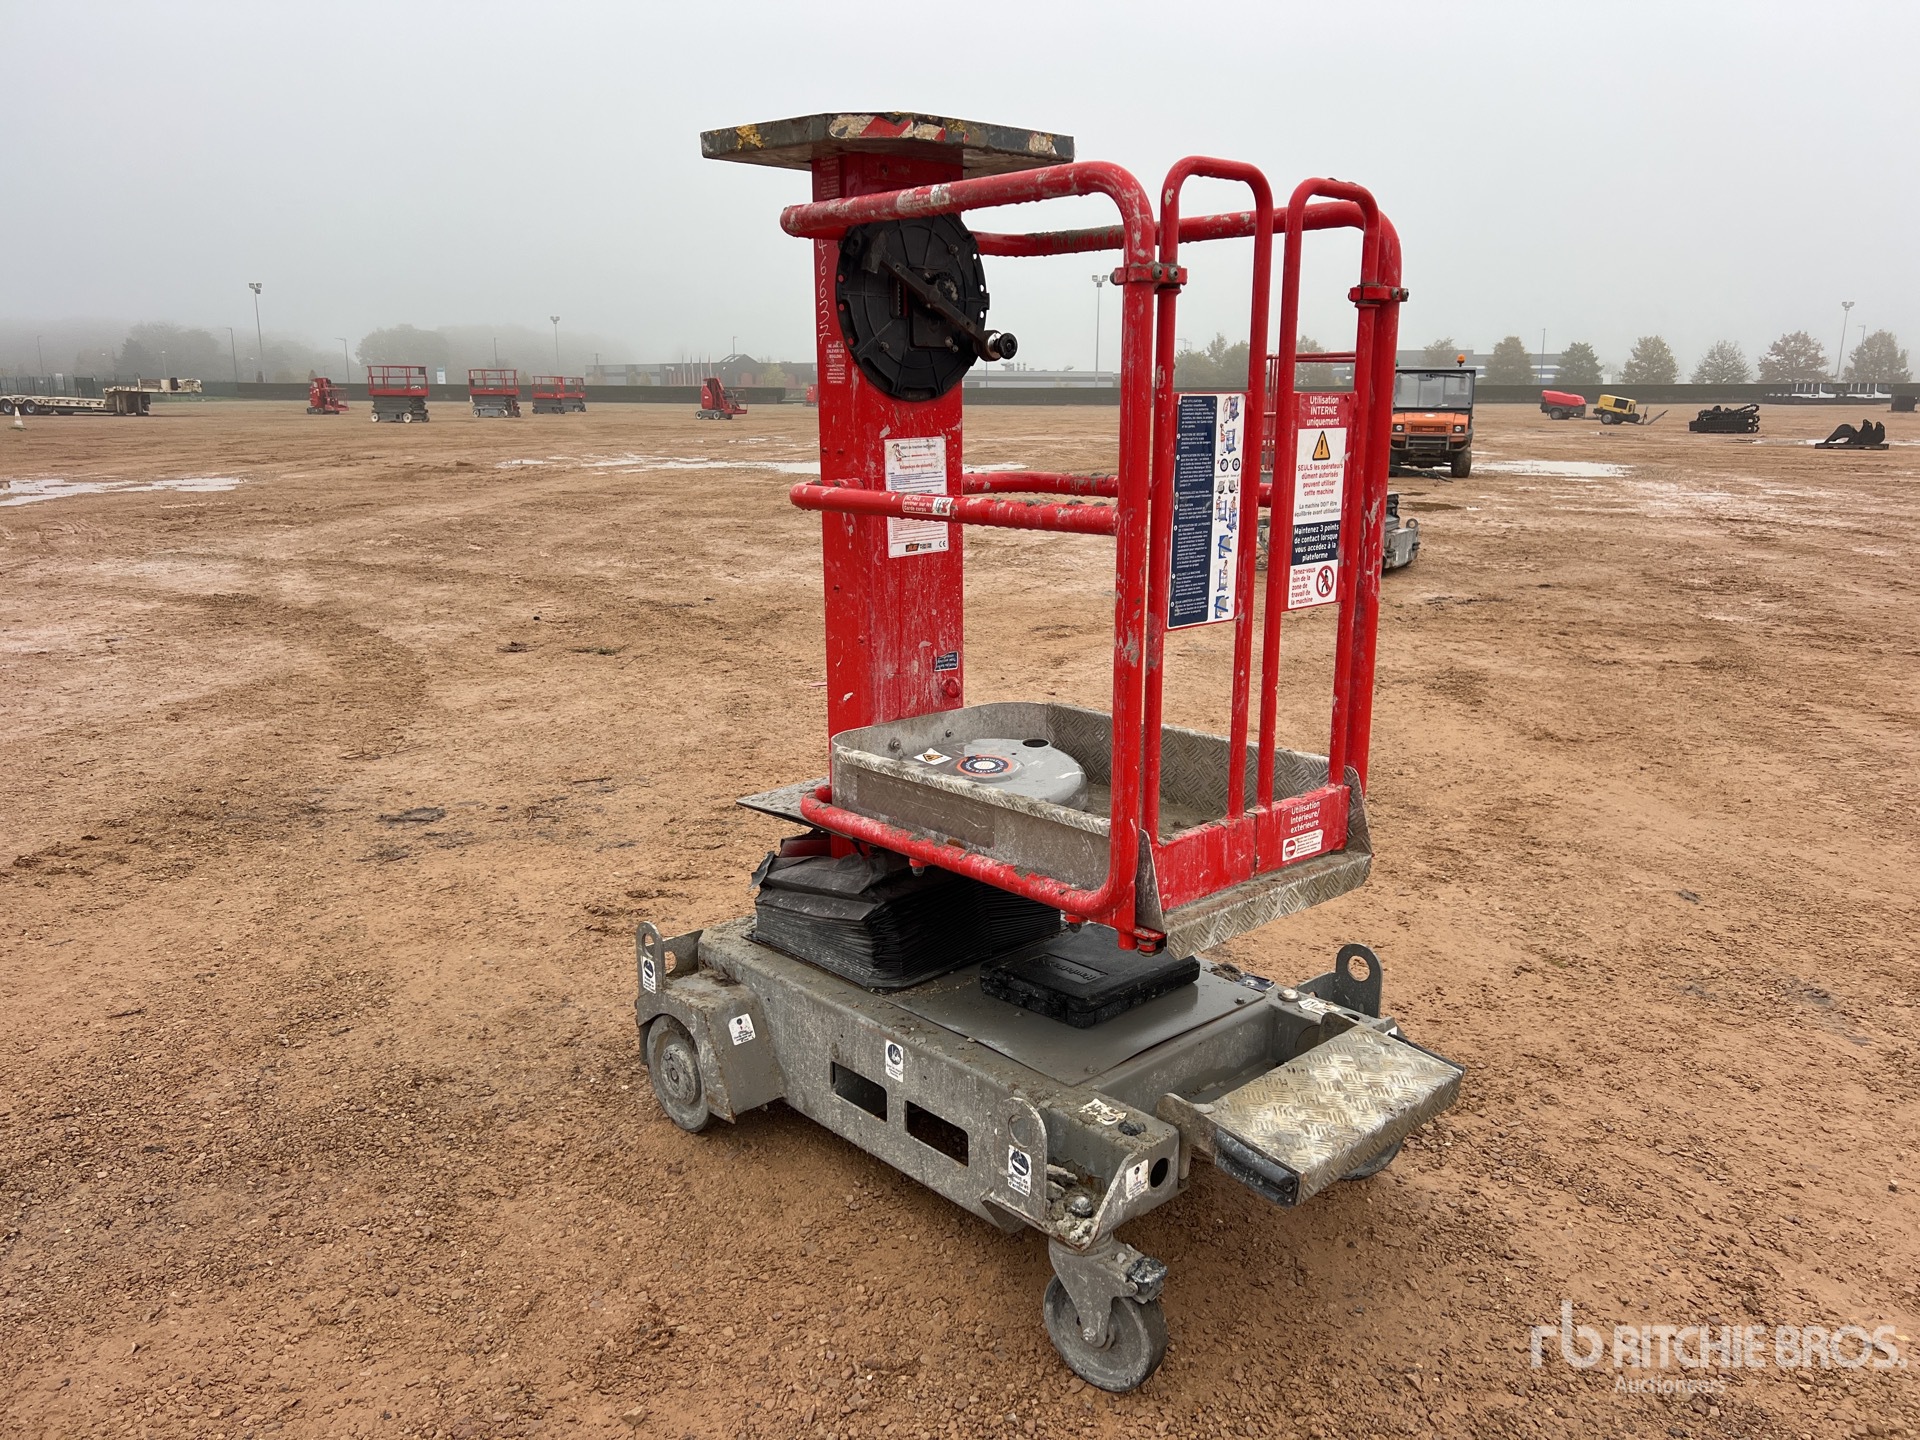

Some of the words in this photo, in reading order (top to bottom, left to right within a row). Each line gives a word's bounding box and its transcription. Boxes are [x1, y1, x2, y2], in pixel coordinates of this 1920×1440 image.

[1310, 396, 1339, 404] Utilisation
[1311, 406, 1337, 415] INTERNE
[1307, 417, 1339, 427] uniquement
[1294, 526, 1319, 535] Maintenez
[1324, 523, 1339, 534] points
[1301, 535, 1320, 543] contact
[1320, 533, 1338, 541] lorsque
[1302, 552, 1328, 562] plateforme
[1291, 801, 1320, 815] Utilisation
[1290, 820, 1319, 833] extérieure
